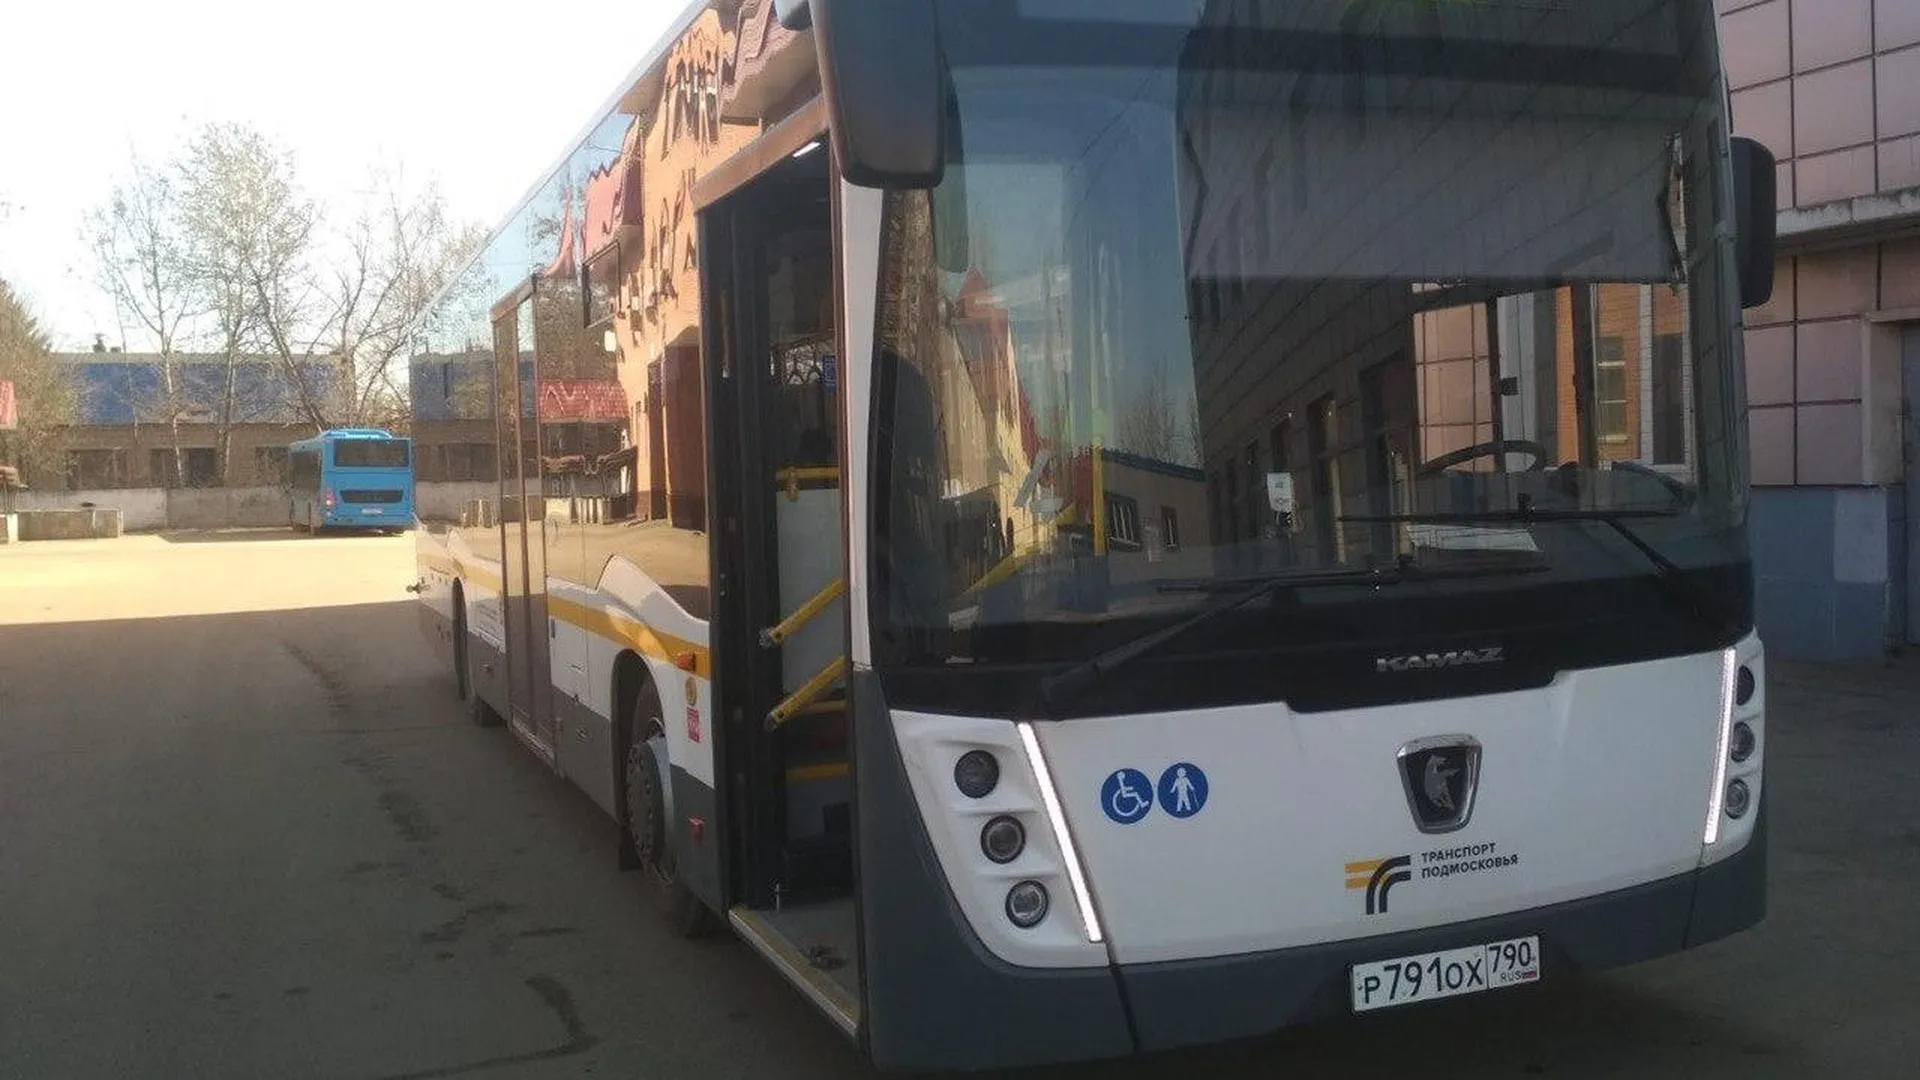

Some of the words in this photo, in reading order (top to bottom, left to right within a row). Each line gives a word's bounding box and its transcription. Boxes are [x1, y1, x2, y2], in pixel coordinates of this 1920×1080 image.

[1376, 647, 1503, 671] KAMAZ
[1421, 842, 1497, 863] ТРАНСПОРТ
[1421, 854, 1519, 879] ПОДМОСКОВЬЯ
[1488, 941, 1532, 973] 790
[1500, 971, 1522, 983] RUS
